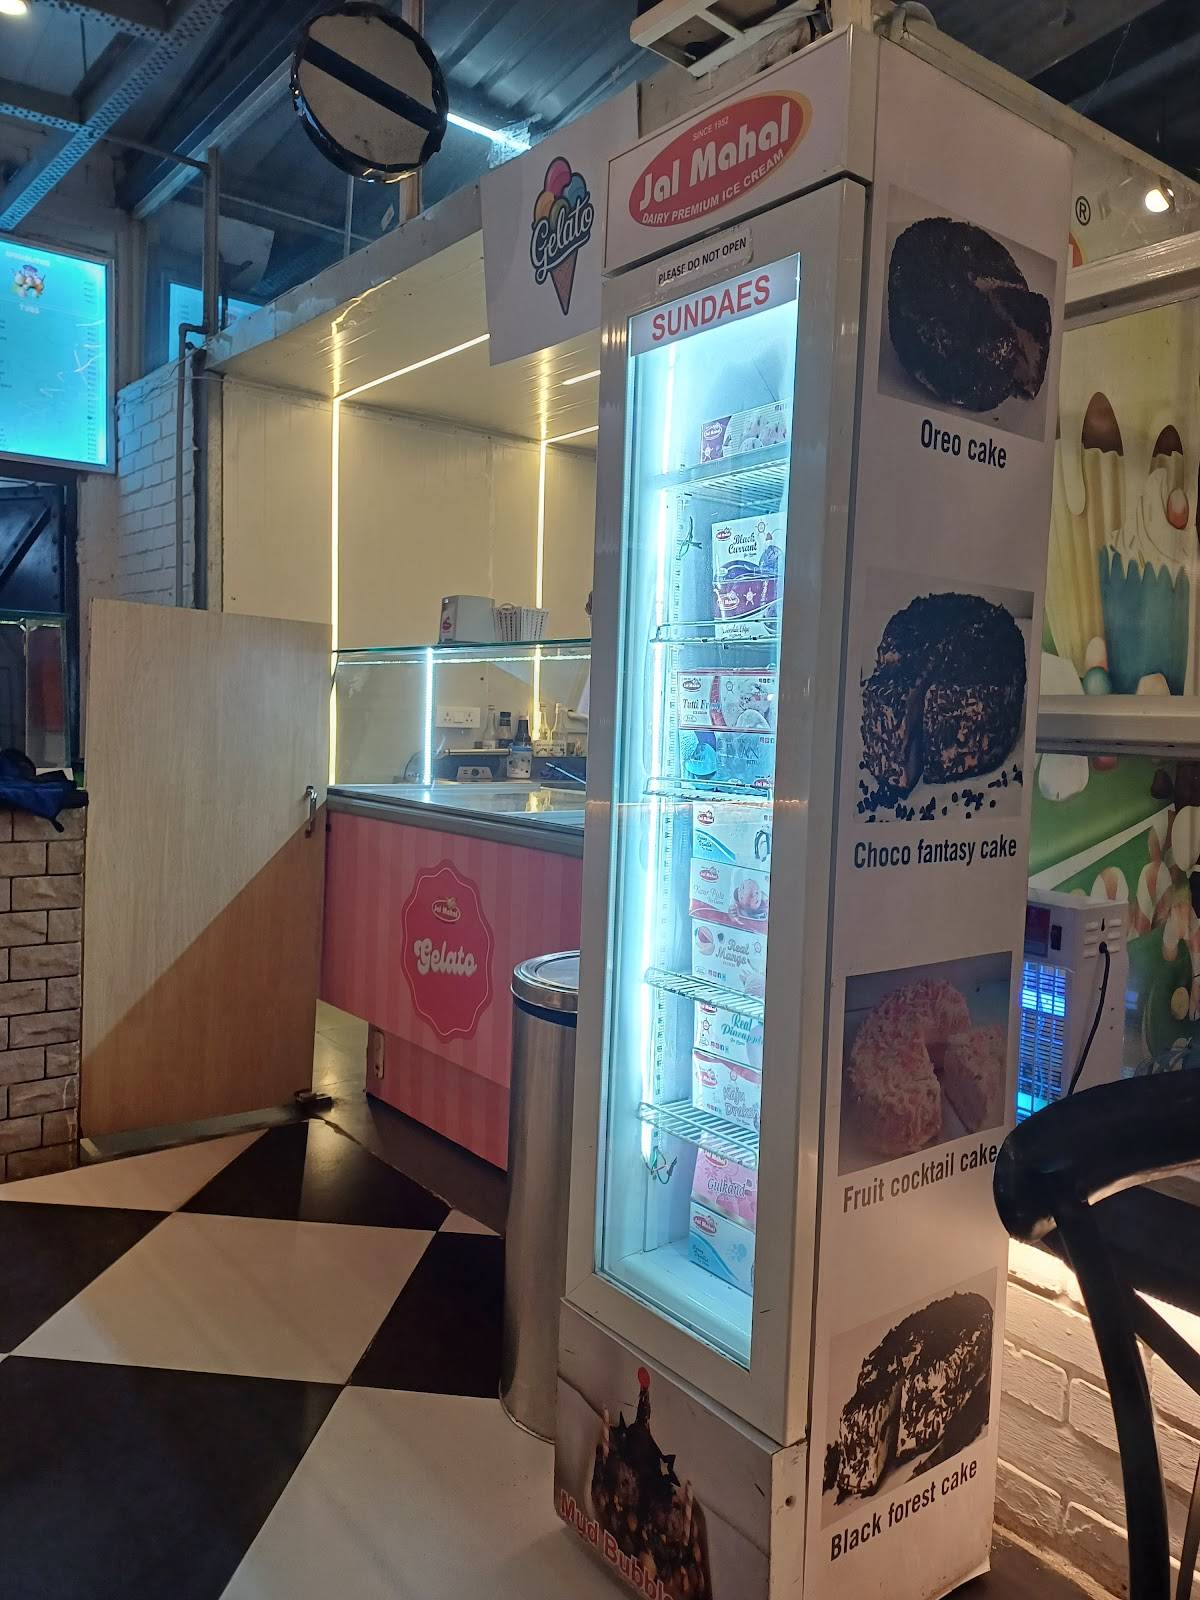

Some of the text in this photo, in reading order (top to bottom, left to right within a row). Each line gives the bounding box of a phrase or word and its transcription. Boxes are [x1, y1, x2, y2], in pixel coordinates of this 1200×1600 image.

[640, 101, 791, 211] Jal Mahal
[692, 124, 713, 141] SINCE
[642, 148, 785, 225] DAIRY PREMIUM ICE CREAM
[532, 196, 593, 281] Gelato
[658, 237, 747, 285] PLEASE DO NOT OPEN
[652, 275, 770, 341] SUNDAES
[921, 418, 1007, 468] Oreo cake
[728, 543, 758, 555] Currant
[854, 834, 1017, 869] Choco fantasy cake
[413, 937, 477, 977] Gelato
[716, 946, 747, 968] Mango
[728, 939, 750, 955] Real
[731, 1013, 753, 1032] Real
[707, 1178, 747, 1198] Gulkand
[843, 1143, 998, 1213] Fruit cocktail cake
[560, 1488, 600, 1547] Mud
[830, 1460, 977, 1562] Black forest cake
